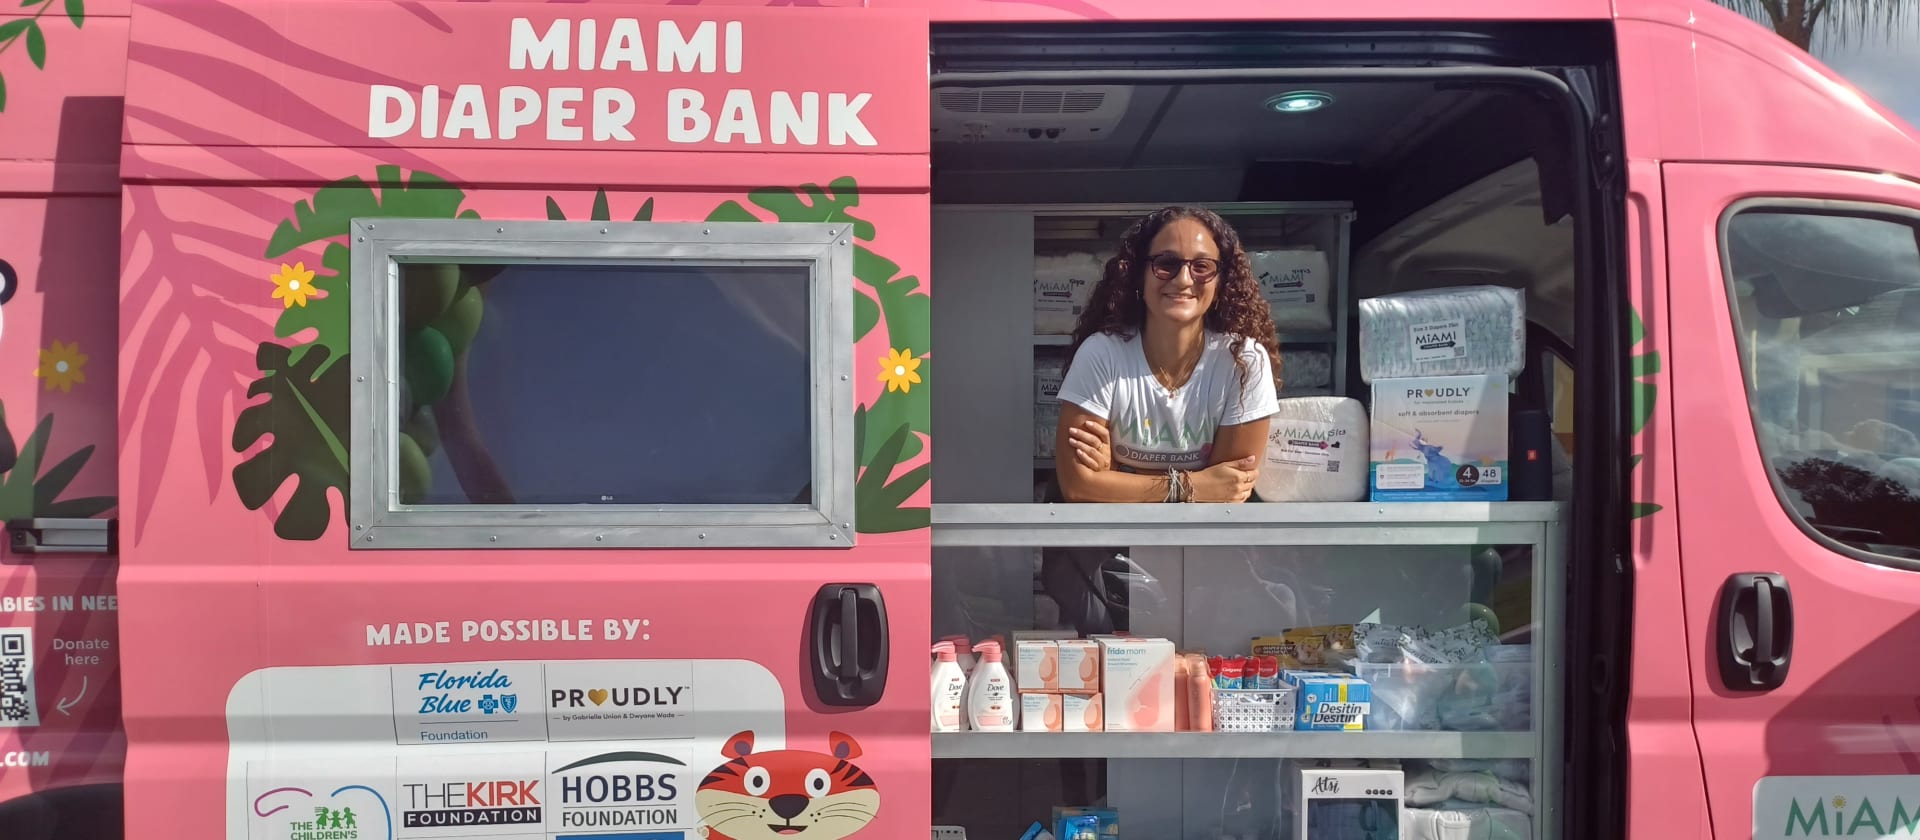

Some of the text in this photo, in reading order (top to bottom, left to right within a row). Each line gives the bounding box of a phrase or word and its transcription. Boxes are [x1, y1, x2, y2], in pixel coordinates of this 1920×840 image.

[509, 17, 743, 74] MIAMI
[368, 84, 878, 146] DIAPER BANK
[1131, 450, 1200, 463] DIAPER BANK
[1463, 467, 1472, 479] 4
[1482, 469, 1497, 478] 48
[0, 596, 45, 612] BIES
[52, 596, 74, 611] IN
[366, 618, 650, 646] MADE POSSIBLE BY:
[53, 638, 110, 650] Donate
[65, 653, 99, 665] here
[418, 668, 512, 690] Florida
[987, 684, 1005, 692] Dove
[418, 693, 472, 713] Blue
[1320, 703, 1362, 714] Desitin
[420, 730, 489, 741] Foundation
[562, 774, 677, 803] HOBBS
[407, 809, 538, 825] FOUNDATION
[562, 809, 677, 827] FOUNDATION
[290, 822, 313, 831] THE
